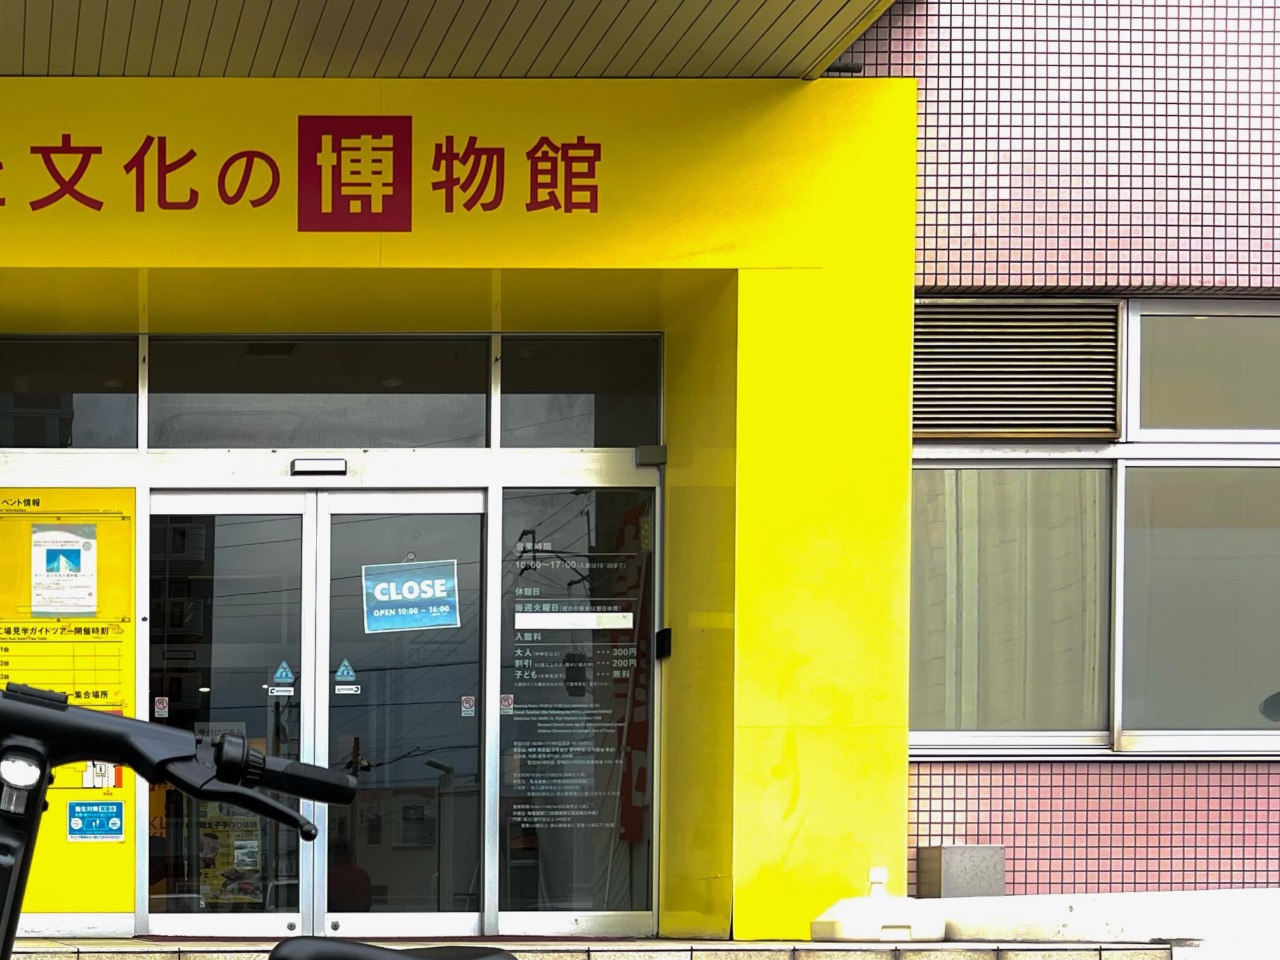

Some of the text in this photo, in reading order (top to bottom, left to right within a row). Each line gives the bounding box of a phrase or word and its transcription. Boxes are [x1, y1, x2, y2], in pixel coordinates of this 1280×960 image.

[374, 579, 447, 601] CLOSE
[397, 607, 418, 615] 10:00
[429, 605, 450, 613] 16:00
